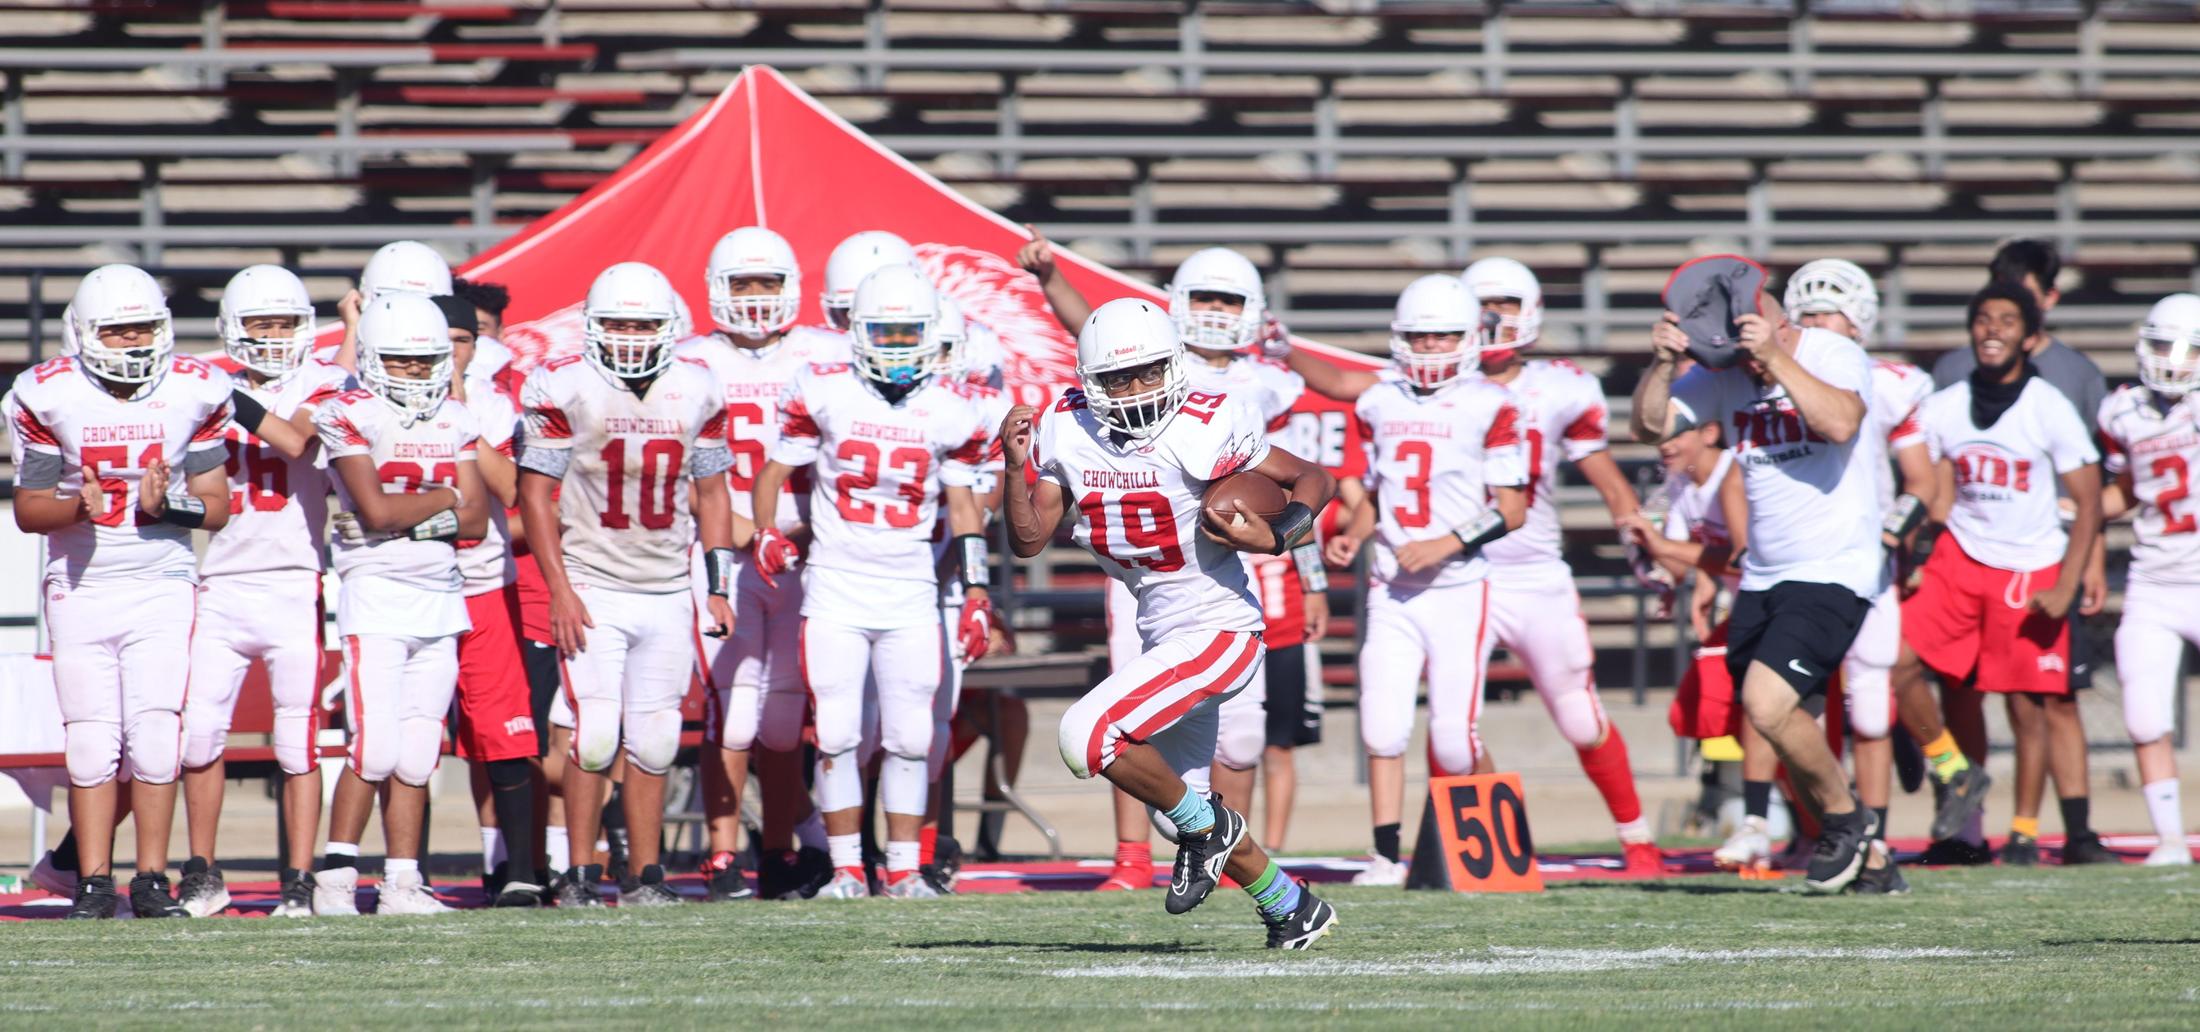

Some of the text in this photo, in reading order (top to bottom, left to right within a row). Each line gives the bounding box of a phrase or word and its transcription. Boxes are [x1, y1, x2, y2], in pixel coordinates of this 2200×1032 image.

[82, 424, 165, 443] CHOWCHILLA
[605, 418, 683, 434] CHOWCHILLA
[1177, 392, 1227, 425] 19
[80, 443, 165, 528] 51
[600, 438, 684, 529] 10
[837, 439, 931, 528] 23
[1083, 470, 1159, 490] CHOWCHILLA
[1394, 441, 1432, 528] 3
[2151, 454, 2197, 535] 2
[1078, 491, 1186, 573] 19
[1448, 781, 1533, 880] 50
